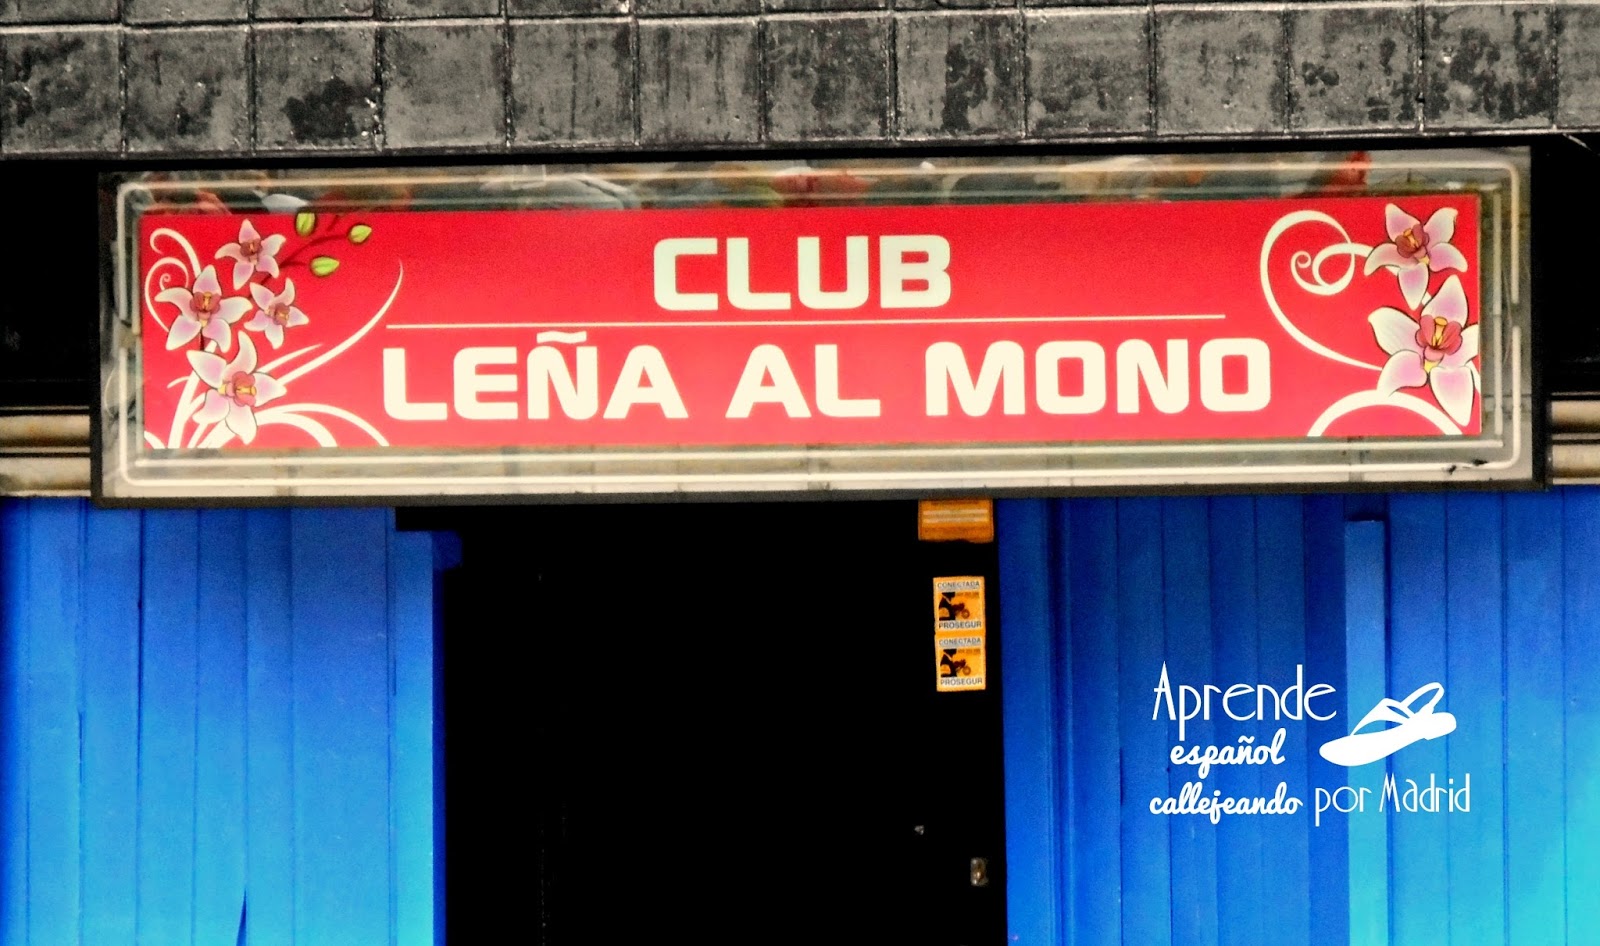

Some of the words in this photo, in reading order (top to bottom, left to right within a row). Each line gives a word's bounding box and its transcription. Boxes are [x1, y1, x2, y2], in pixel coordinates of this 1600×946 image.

[654, 235, 952, 311] CLUB
[383, 331, 689, 421] LEÑA
[725, 344, 881, 419] AL
[925, 338, 1271, 417] MONO
[938, 621, 982, 630] PROSEGUR
[938, 637, 981, 645] CONECTADA
[940, 678, 983, 686] PROSEGUR
